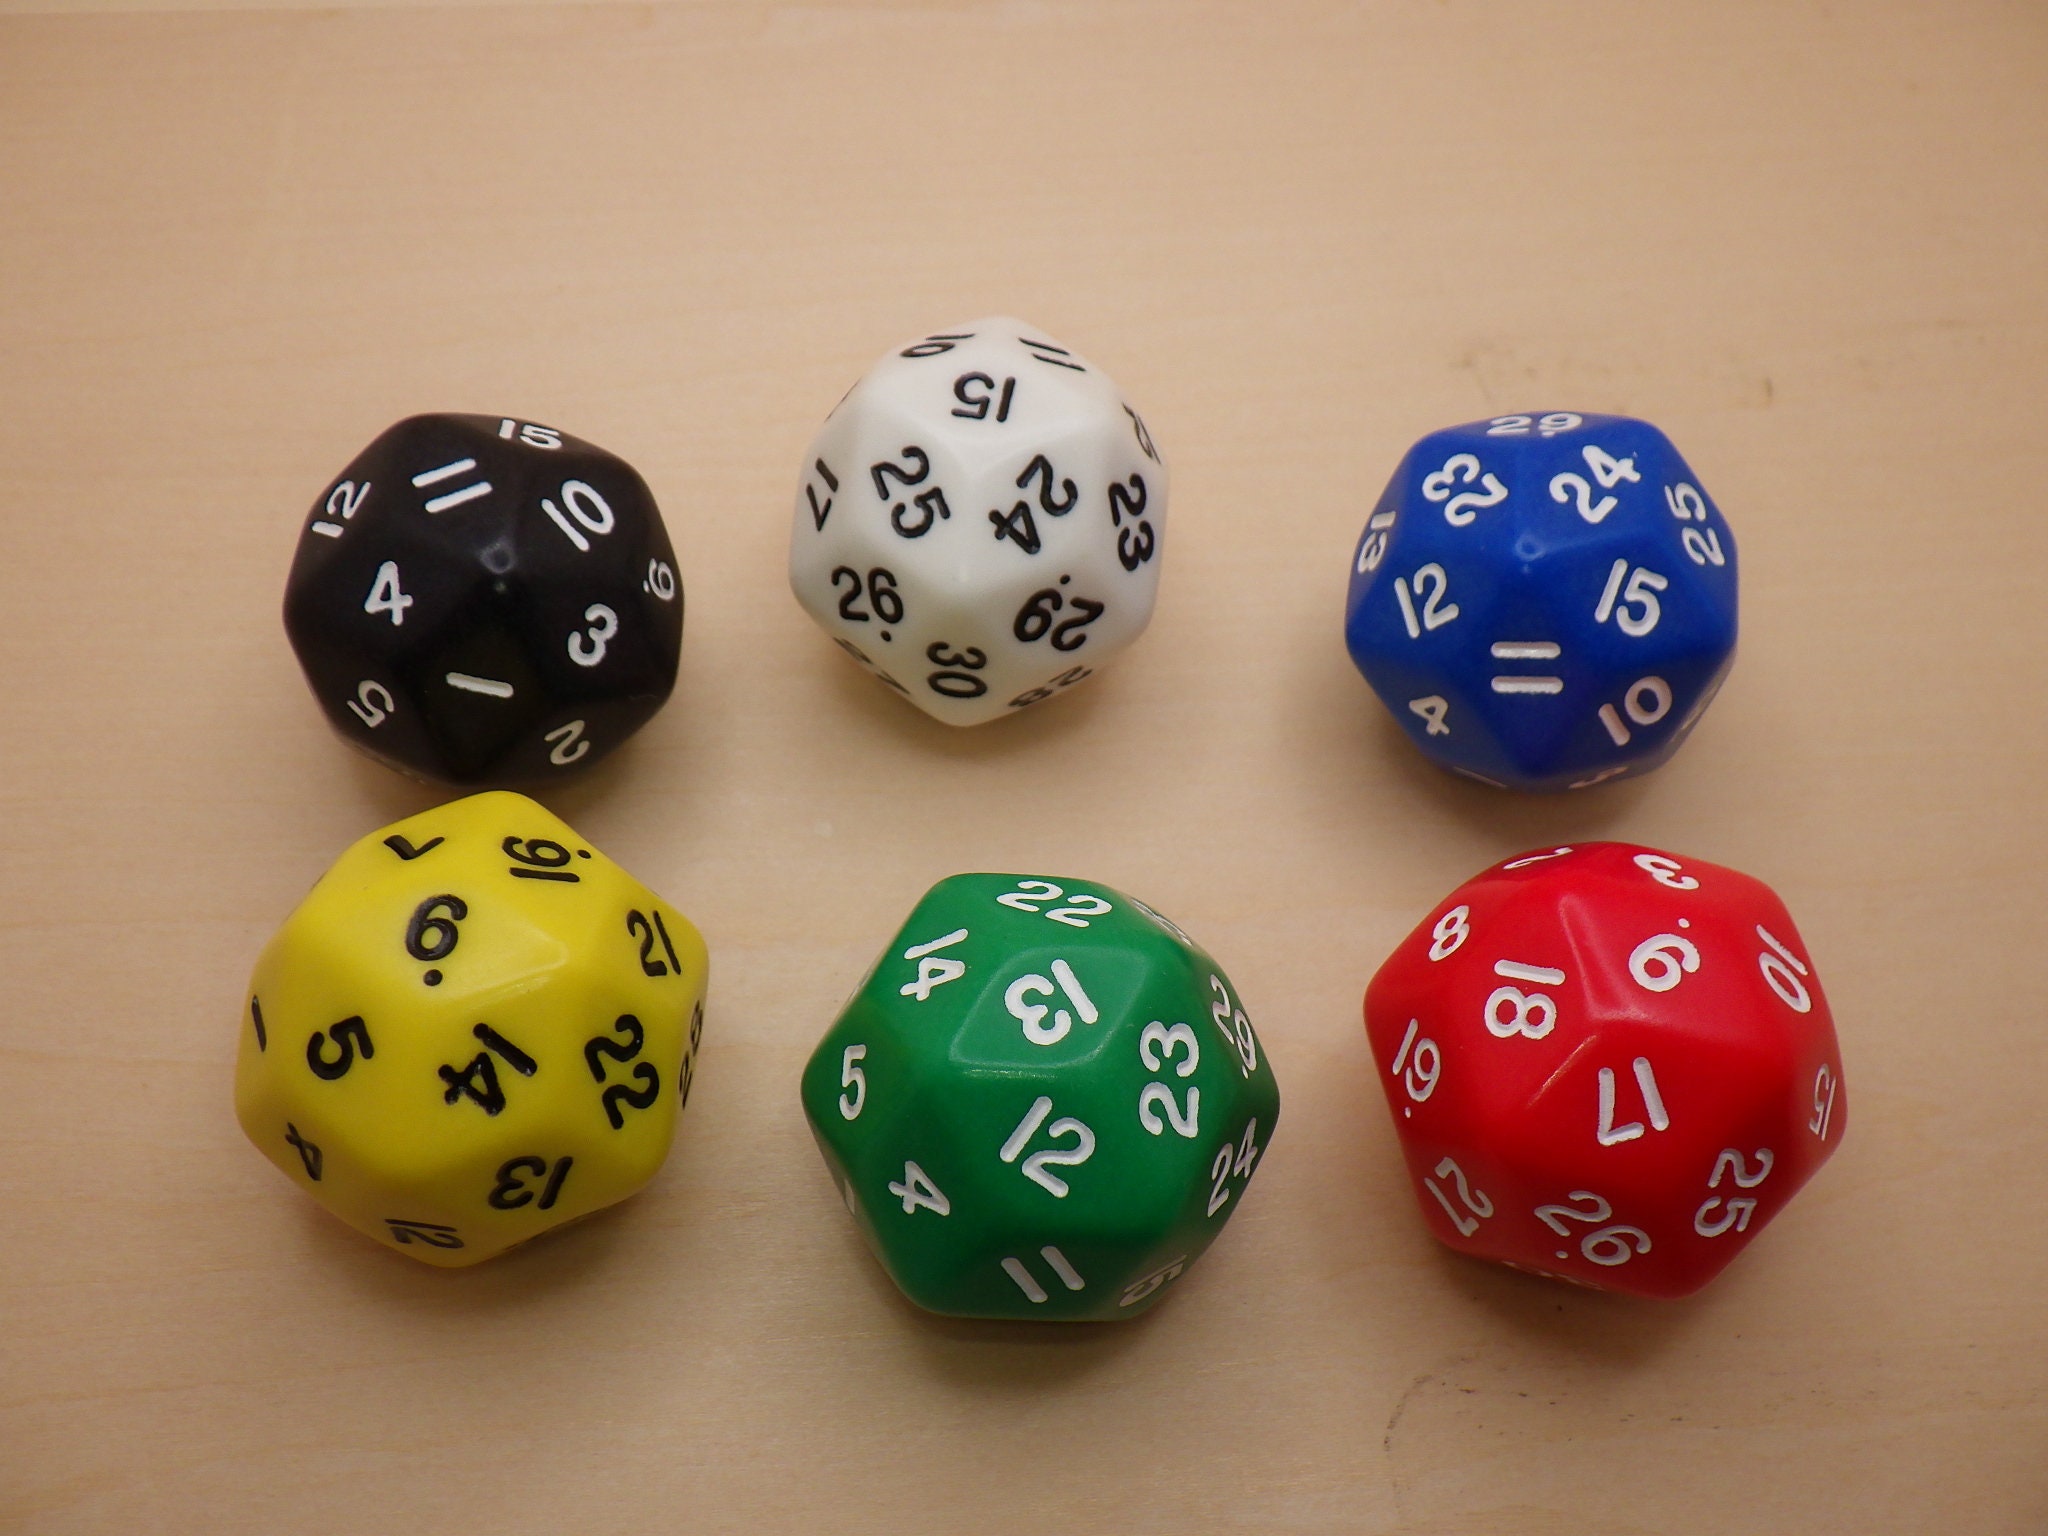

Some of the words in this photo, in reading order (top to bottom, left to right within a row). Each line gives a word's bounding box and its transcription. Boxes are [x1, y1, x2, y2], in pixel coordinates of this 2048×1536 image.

[951, 371, 1016, 423] 15
[499, 419, 563, 450] 15
[311, 480, 371, 538] 12
[541, 479, 615, 552] 10
[806, 457, 839, 532] 17
[870, 445, 950, 539] 25
[989, 454, 1078, 555] 24
[1422, 453, 1508, 527] 23
[1549, 445, 1641, 524] 24
[1108, 473, 1155, 571] 23
[1358, 511, 1396, 574] 13
[1664, 482, 1725, 566] 25
[364, 561, 413, 626] 4
[1394, 563, 1460, 639] 12
[1594, 558, 1668, 637] 15
[568, 603, 618, 667] 3
[927, 641, 988, 699] 30
[347, 680, 394, 728] 5
[446, 672, 514, 698] 1
[1409, 695, 1450, 736] 4
[1598, 675, 1673, 747] 10
[544, 720, 590, 765] 2
[996, 880, 1112, 927] 22
[1633, 853, 1699, 890] 3
[626, 909, 682, 976] 21
[899, 928, 969, 1002] 14
[1428, 904, 1470, 962] 8
[1756, 924, 1812, 1013] 10
[1004, 959, 1099, 1046] 13
[1484, 959, 1566, 1040] 18
[307, 1015, 374, 1081] 5
[438, 1023, 537, 1117] 14
[584, 1013, 660, 1130] 22
[839, 1044, 867, 1120] 5
[1138, 1021, 1200, 1138] 23
[1597, 1056, 1670, 1146] 17
[1809, 1063, 1837, 1142] 15
[286, 1123, 322, 1181] 4
[488, 1156, 573, 1210] 13
[999, 1095, 1096, 1199] 12
[1207, 1117, 1257, 1218] 24
[888, 1160, 950, 1216] 4
[1694, 1148, 1774, 1238] 25
[385, 1218, 465, 1250] 12
